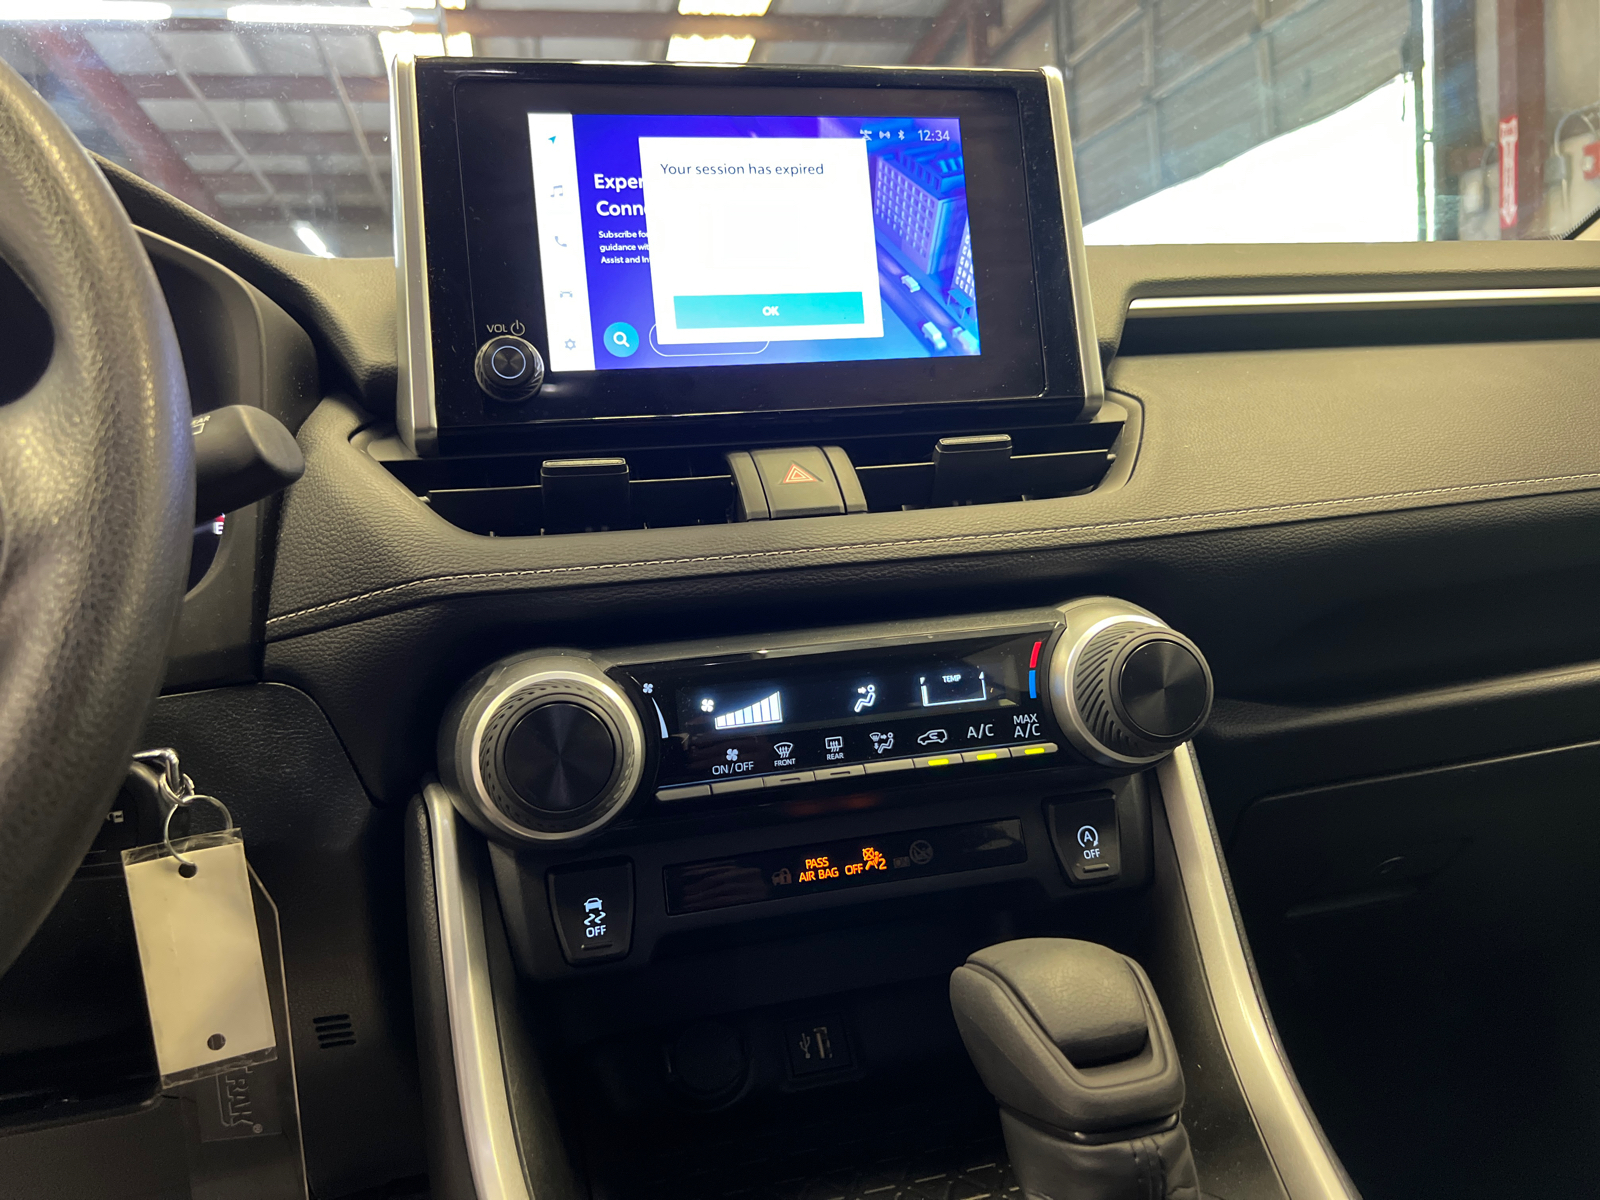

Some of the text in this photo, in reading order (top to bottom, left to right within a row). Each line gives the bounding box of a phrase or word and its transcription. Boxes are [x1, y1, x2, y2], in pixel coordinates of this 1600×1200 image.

[917, 129, 951, 141] 12:34
[660, 163, 824, 177] Your session has expired
[596, 200, 646, 216] Conn
[598, 230, 637, 239] Subscribe
[599, 243, 636, 253] guidance
[600, 256, 624, 264] Assist
[624, 255, 640, 264] and
[762, 305, 780, 317] OK
[486, 324, 508, 333] VOL
[212, 521, 224, 535] E
[942, 674, 962, 684] TEMP
[1013, 713, 1039, 725] MAX
[967, 724, 995, 739] A/C
[1014, 724, 1041, 739] A/C
[826, 752, 844, 761] REAR
[712, 761, 755, 775] ON/OFF
[774, 758, 796, 768] FRONT
[1083, 848, 1101, 860] OFF
[805, 856, 829, 870] PASS
[799, 862, 864, 883] AIR BAG OFF
[585, 924, 607, 938] OFF
